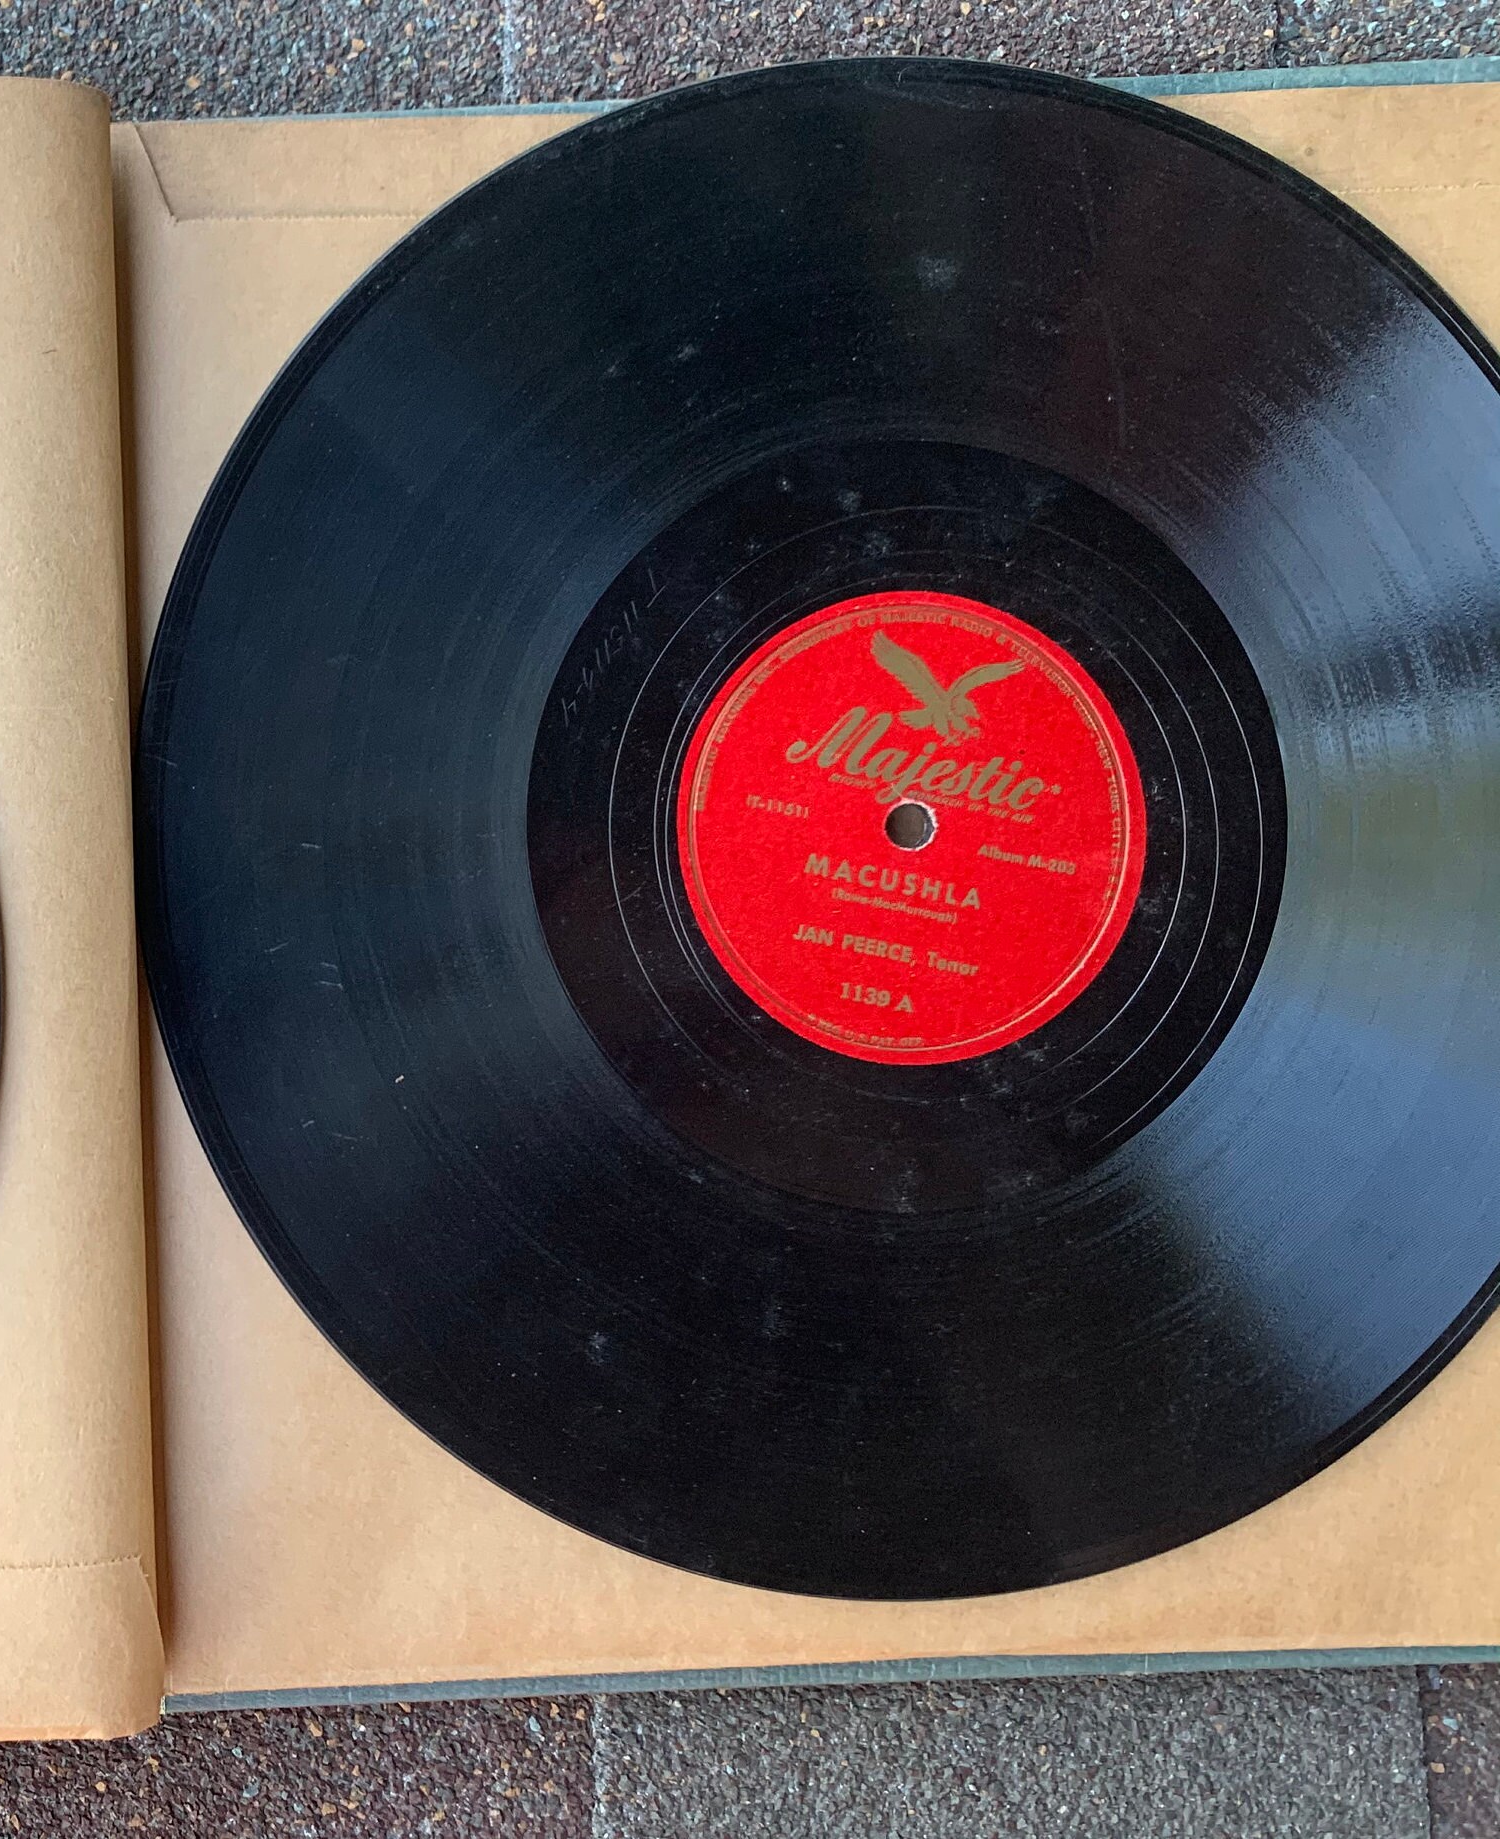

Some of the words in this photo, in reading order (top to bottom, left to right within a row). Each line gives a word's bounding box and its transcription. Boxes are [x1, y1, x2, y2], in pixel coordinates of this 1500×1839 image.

[785, 705, 1046, 811] Majestic
[803, 852, 981, 910] MACUSHLA
[978, 844, 1024, 865] Album
[793, 923, 834, 947] JAN
[841, 934, 918, 967] PEERCE,
[927, 951, 980, 977] Tenor
[840, 981, 891, 1008] 1139
[894, 994, 915, 1014] A
